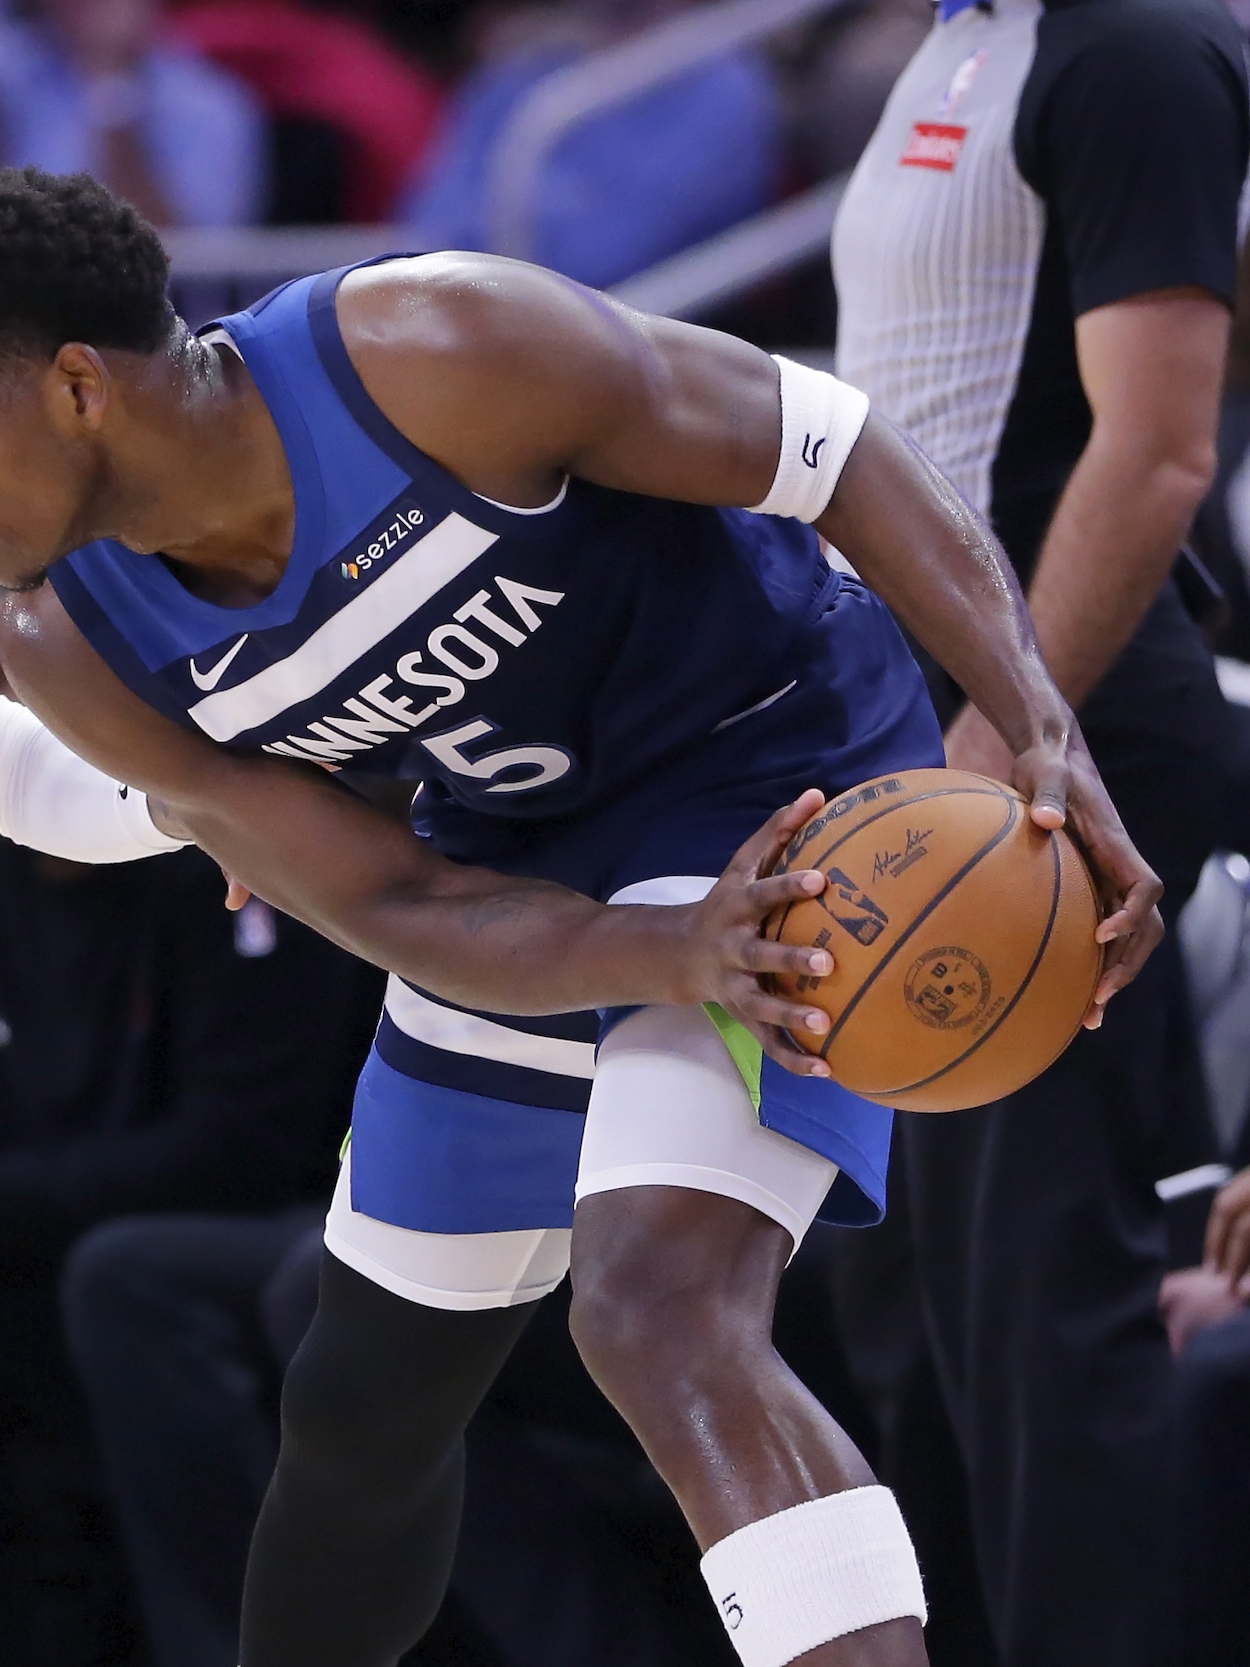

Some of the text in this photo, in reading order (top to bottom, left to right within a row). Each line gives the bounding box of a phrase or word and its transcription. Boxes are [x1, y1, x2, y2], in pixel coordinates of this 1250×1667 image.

[355, 509, 424, 570] sezzle
[261, 575, 566, 772] INNESOTA
[420, 719, 571, 793] 5
[722, 1591, 744, 1630] 5
